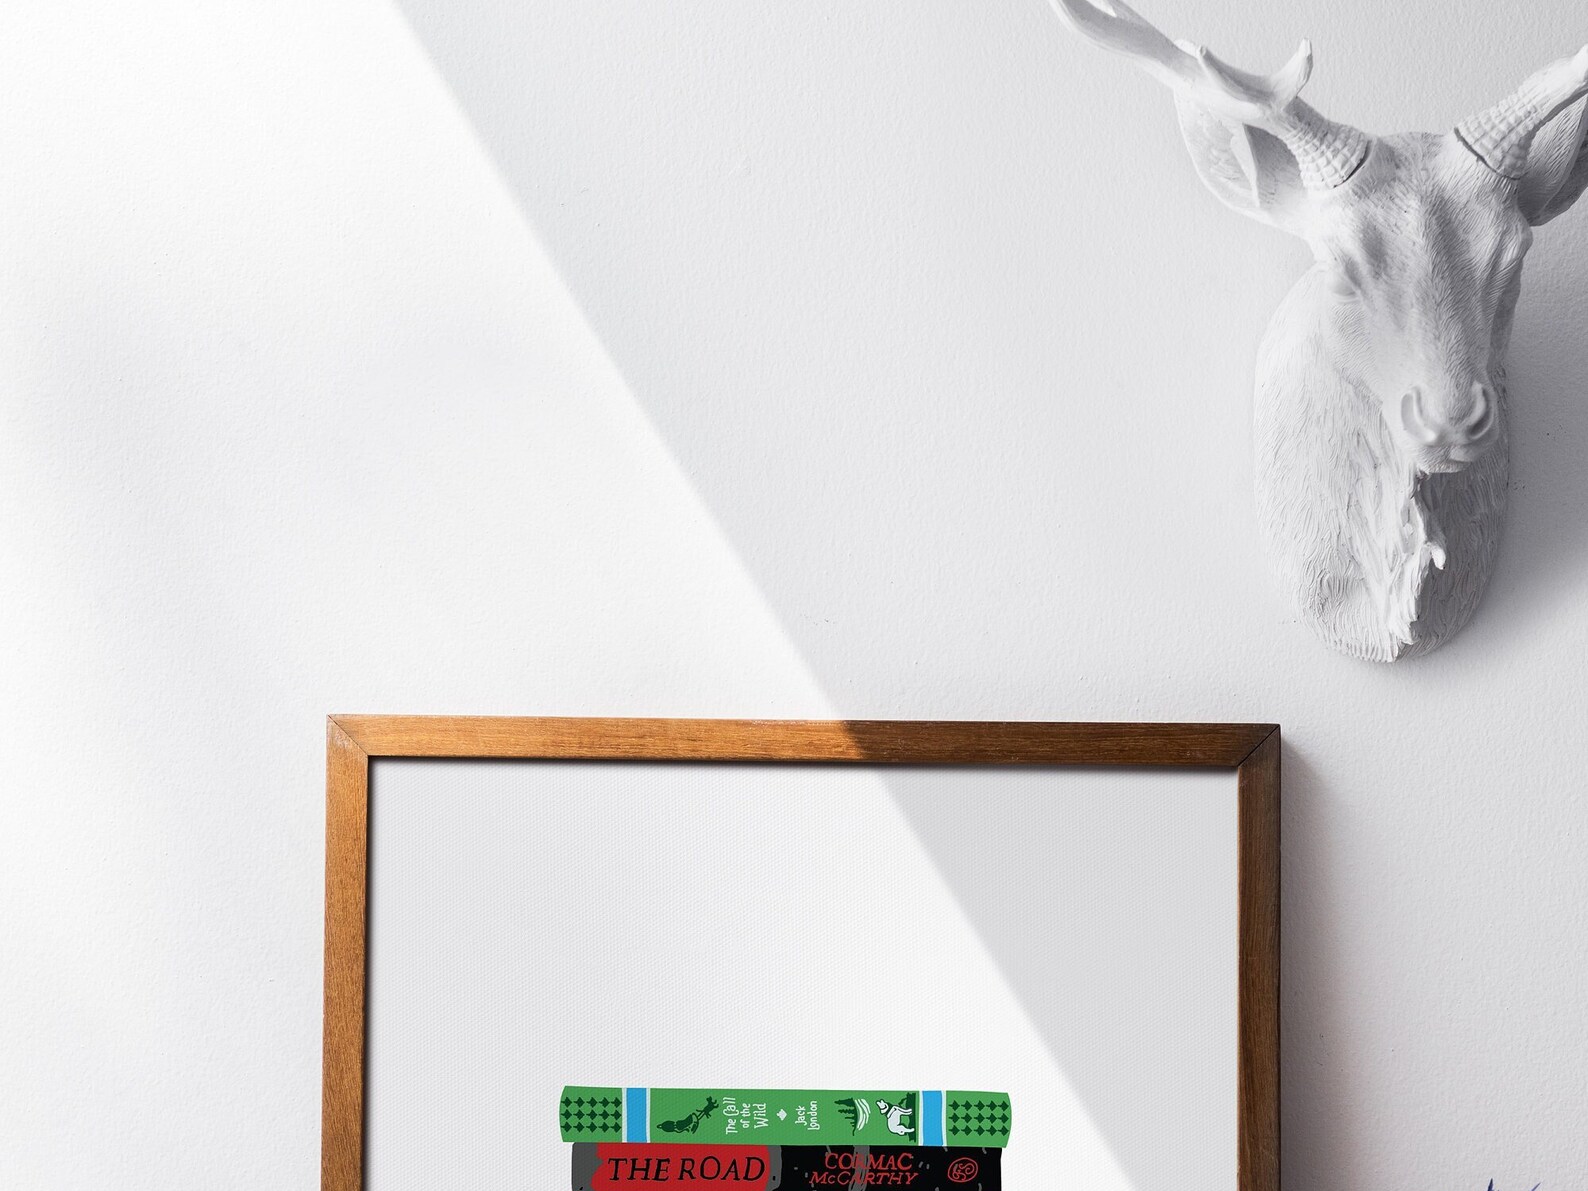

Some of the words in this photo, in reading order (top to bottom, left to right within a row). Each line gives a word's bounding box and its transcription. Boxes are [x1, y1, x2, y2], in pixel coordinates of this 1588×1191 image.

[723, 1097, 739, 1116] Call
[740, 1103, 751, 1117] the
[752, 1102, 769, 1129] Wild
[794, 1105, 808, 1126] Jack
[807, 1100, 820, 1131] London
[726, 1118, 738, 1135] The
[740, 1119, 750, 1128] of
[608, 1157, 671, 1182] THE
[677, 1155, 765, 1182] ROAD
[825, 1152, 914, 1170] CORMAC
